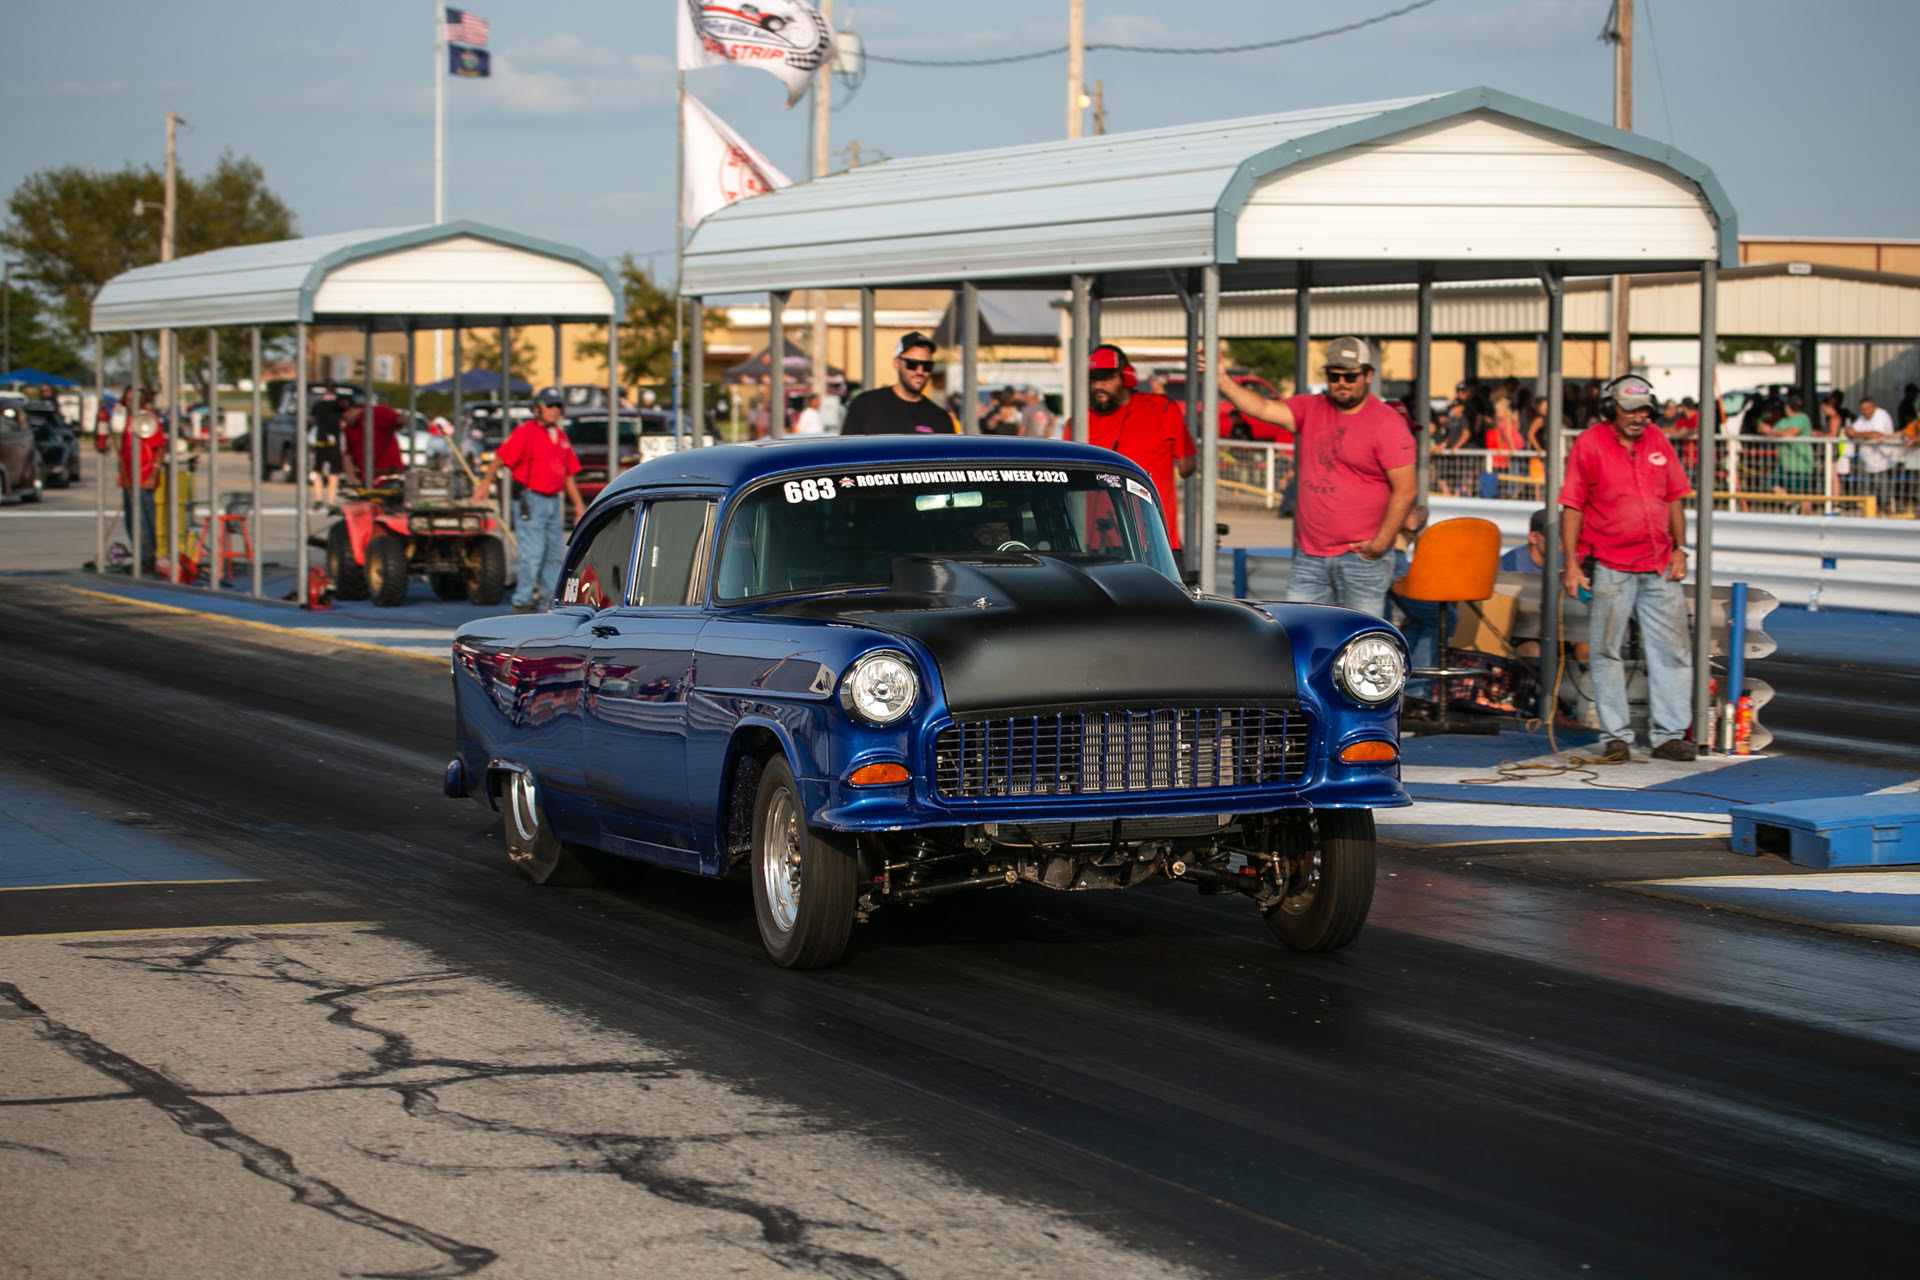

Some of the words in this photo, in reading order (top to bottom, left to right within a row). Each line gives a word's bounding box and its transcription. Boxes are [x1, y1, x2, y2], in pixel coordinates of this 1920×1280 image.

[730, 43, 785, 60] STRIP
[856, 473, 900, 488] ROCKY
[900, 471, 967, 485] MOUNTAIN
[966, 470, 1000, 483] RACE
[999, 470, 1036, 483] WEEK
[1035, 470, 1069, 483] 2020
[783, 477, 837, 504] 683
